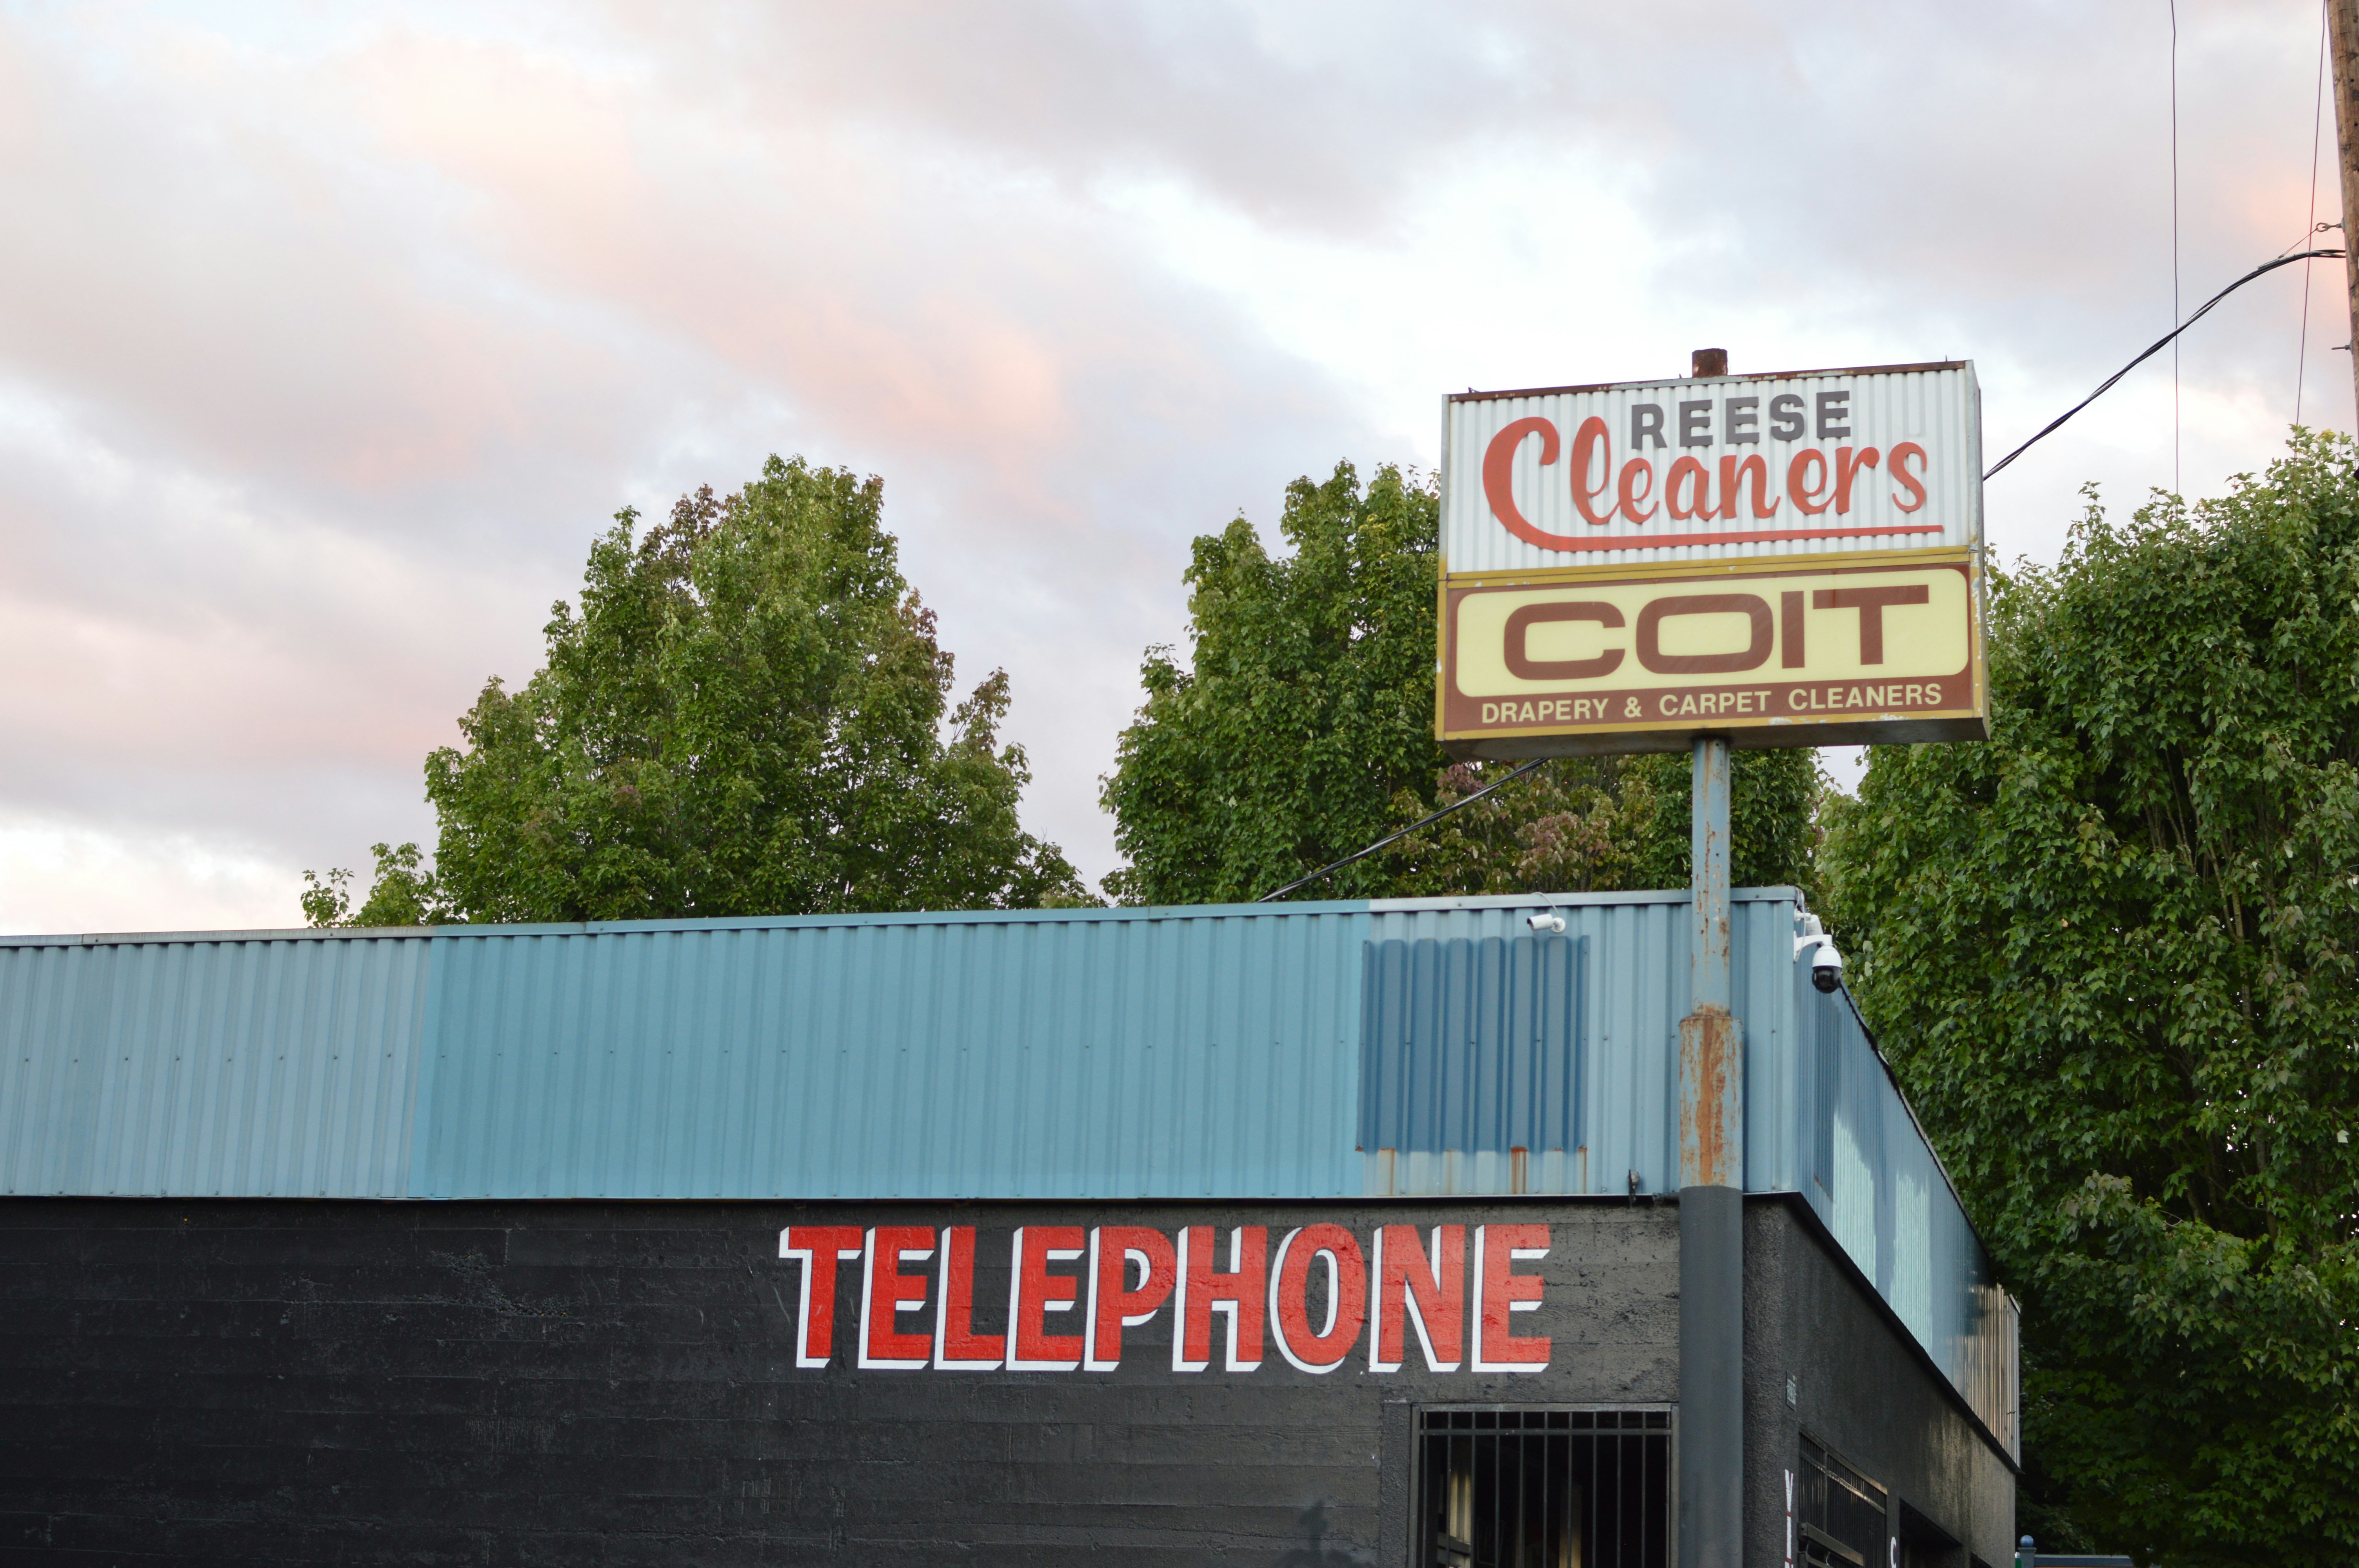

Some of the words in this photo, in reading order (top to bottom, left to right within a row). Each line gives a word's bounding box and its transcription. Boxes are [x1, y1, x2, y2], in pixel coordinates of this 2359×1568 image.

[1631, 390, 1851, 450] REESE
[1483, 417, 1944, 552] Cleaners
[1504, 584, 1929, 680] COIT
[1482, 698, 1609, 724] DRAPERY
[1624, 697, 1642, 718] &
[1659, 691, 1772, 715] CARPET
[1788, 683, 1942, 710] CLEANERS
[779, 1223, 1552, 1375] TELEPHONE
